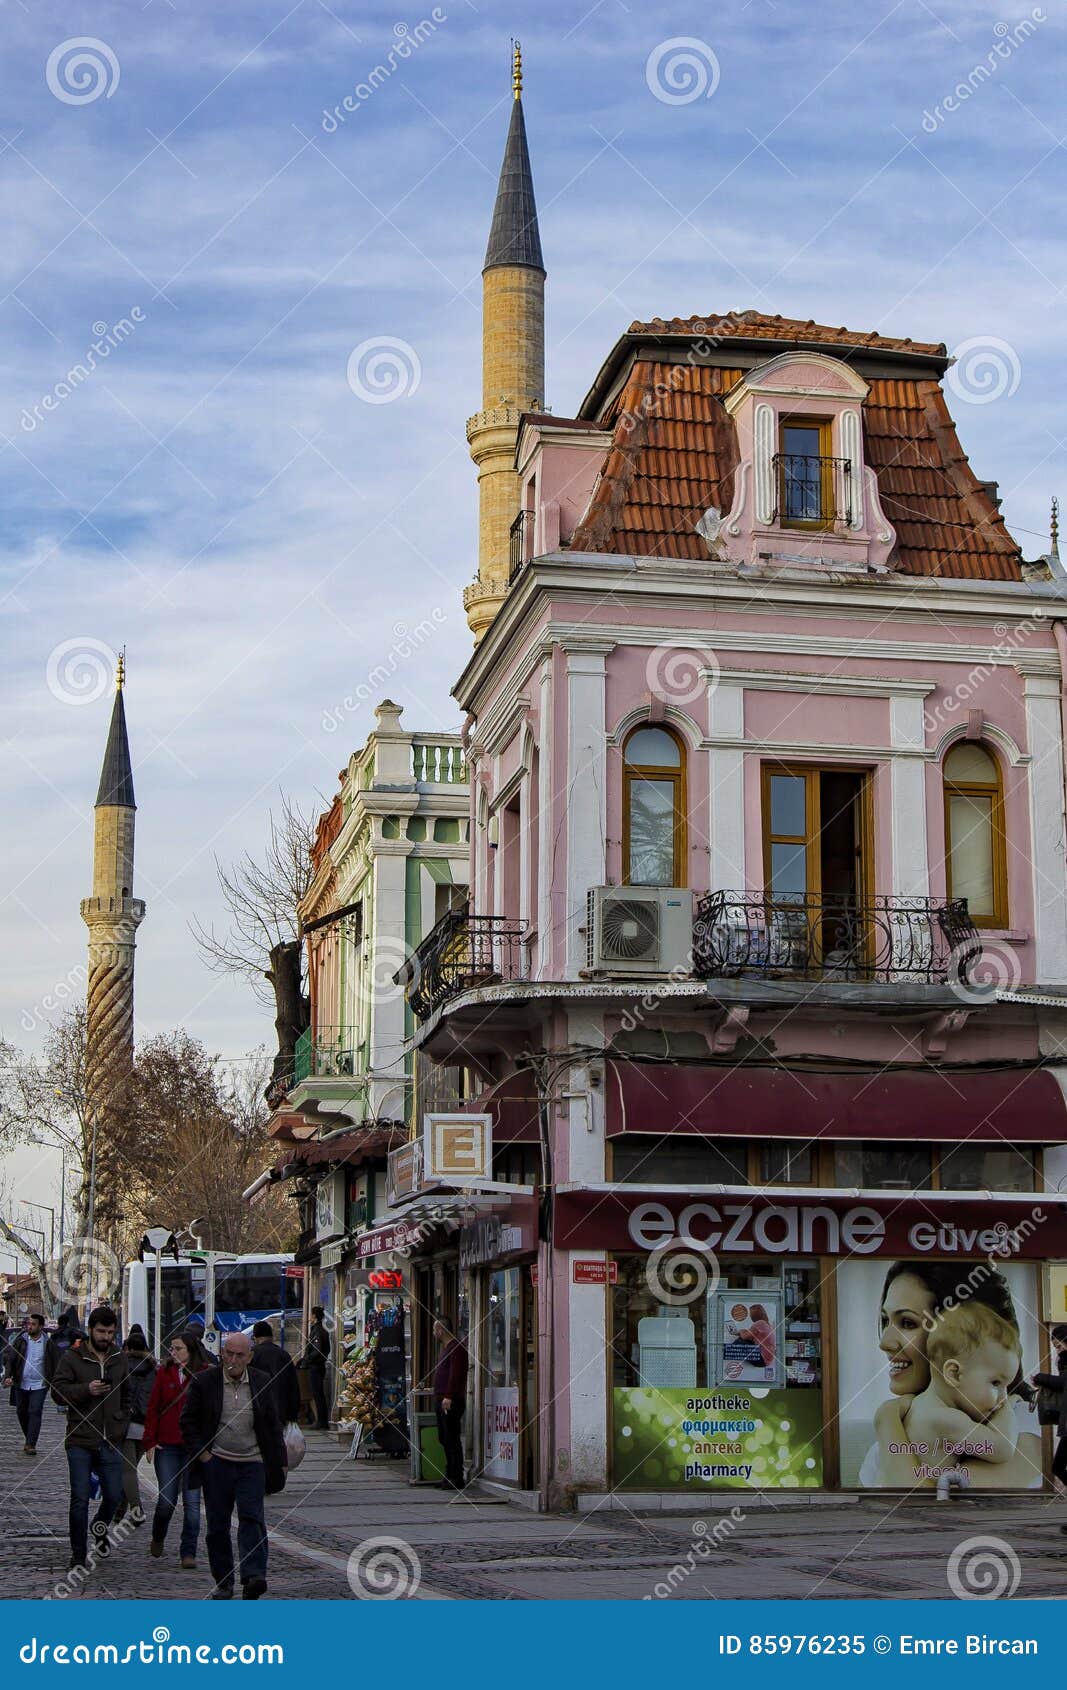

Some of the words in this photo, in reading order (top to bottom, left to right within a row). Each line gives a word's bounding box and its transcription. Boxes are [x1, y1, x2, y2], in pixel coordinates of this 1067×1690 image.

[628, 1202, 886, 1254] eczane
[909, 1222, 1020, 1252] Güven
[687, 1395, 750, 1413] apotheke
[682, 1417, 755, 1436] φαρμακείο
[888, 1442, 929, 1455] anne
[943, 1439, 993, 1454] bebek
[685, 1461, 752, 1480] pharmacy
